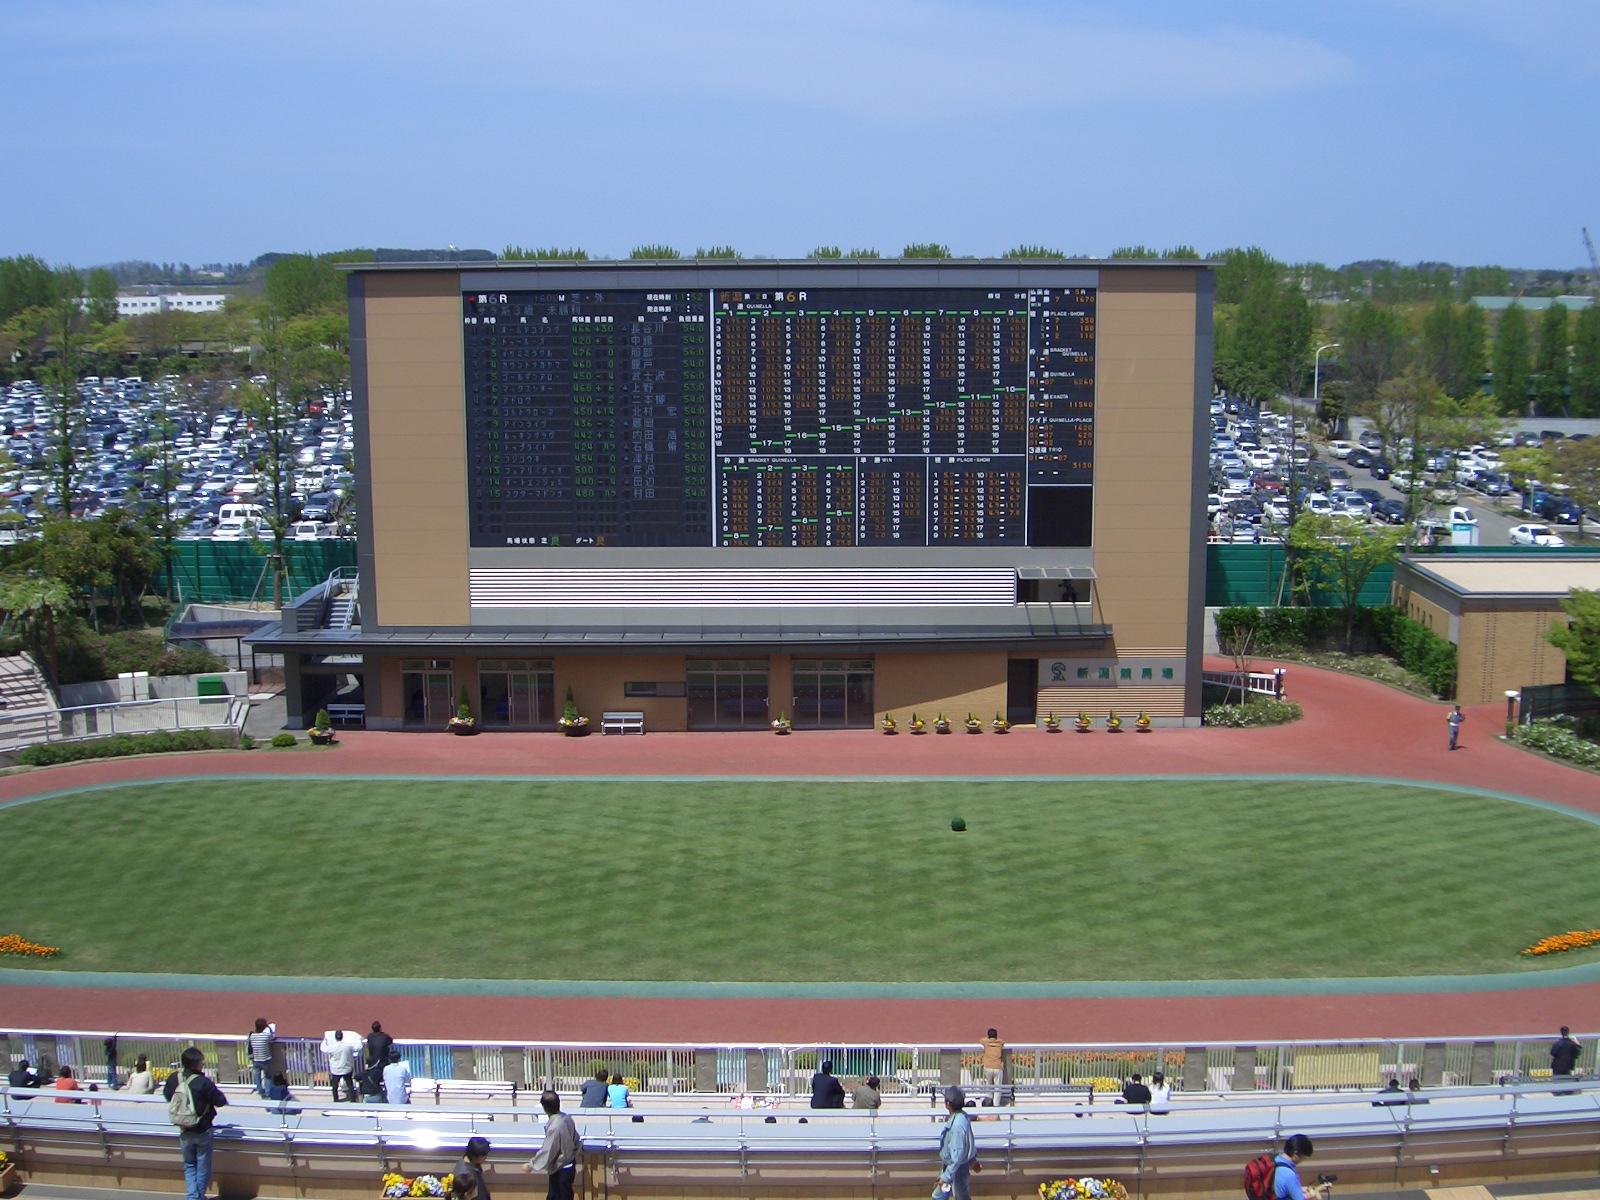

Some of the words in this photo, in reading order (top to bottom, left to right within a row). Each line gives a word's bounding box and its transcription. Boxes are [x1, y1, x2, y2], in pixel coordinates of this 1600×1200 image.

[775, 291, 807, 302] 第6R
[1077, 667, 1174, 680] 新潟競馬場
